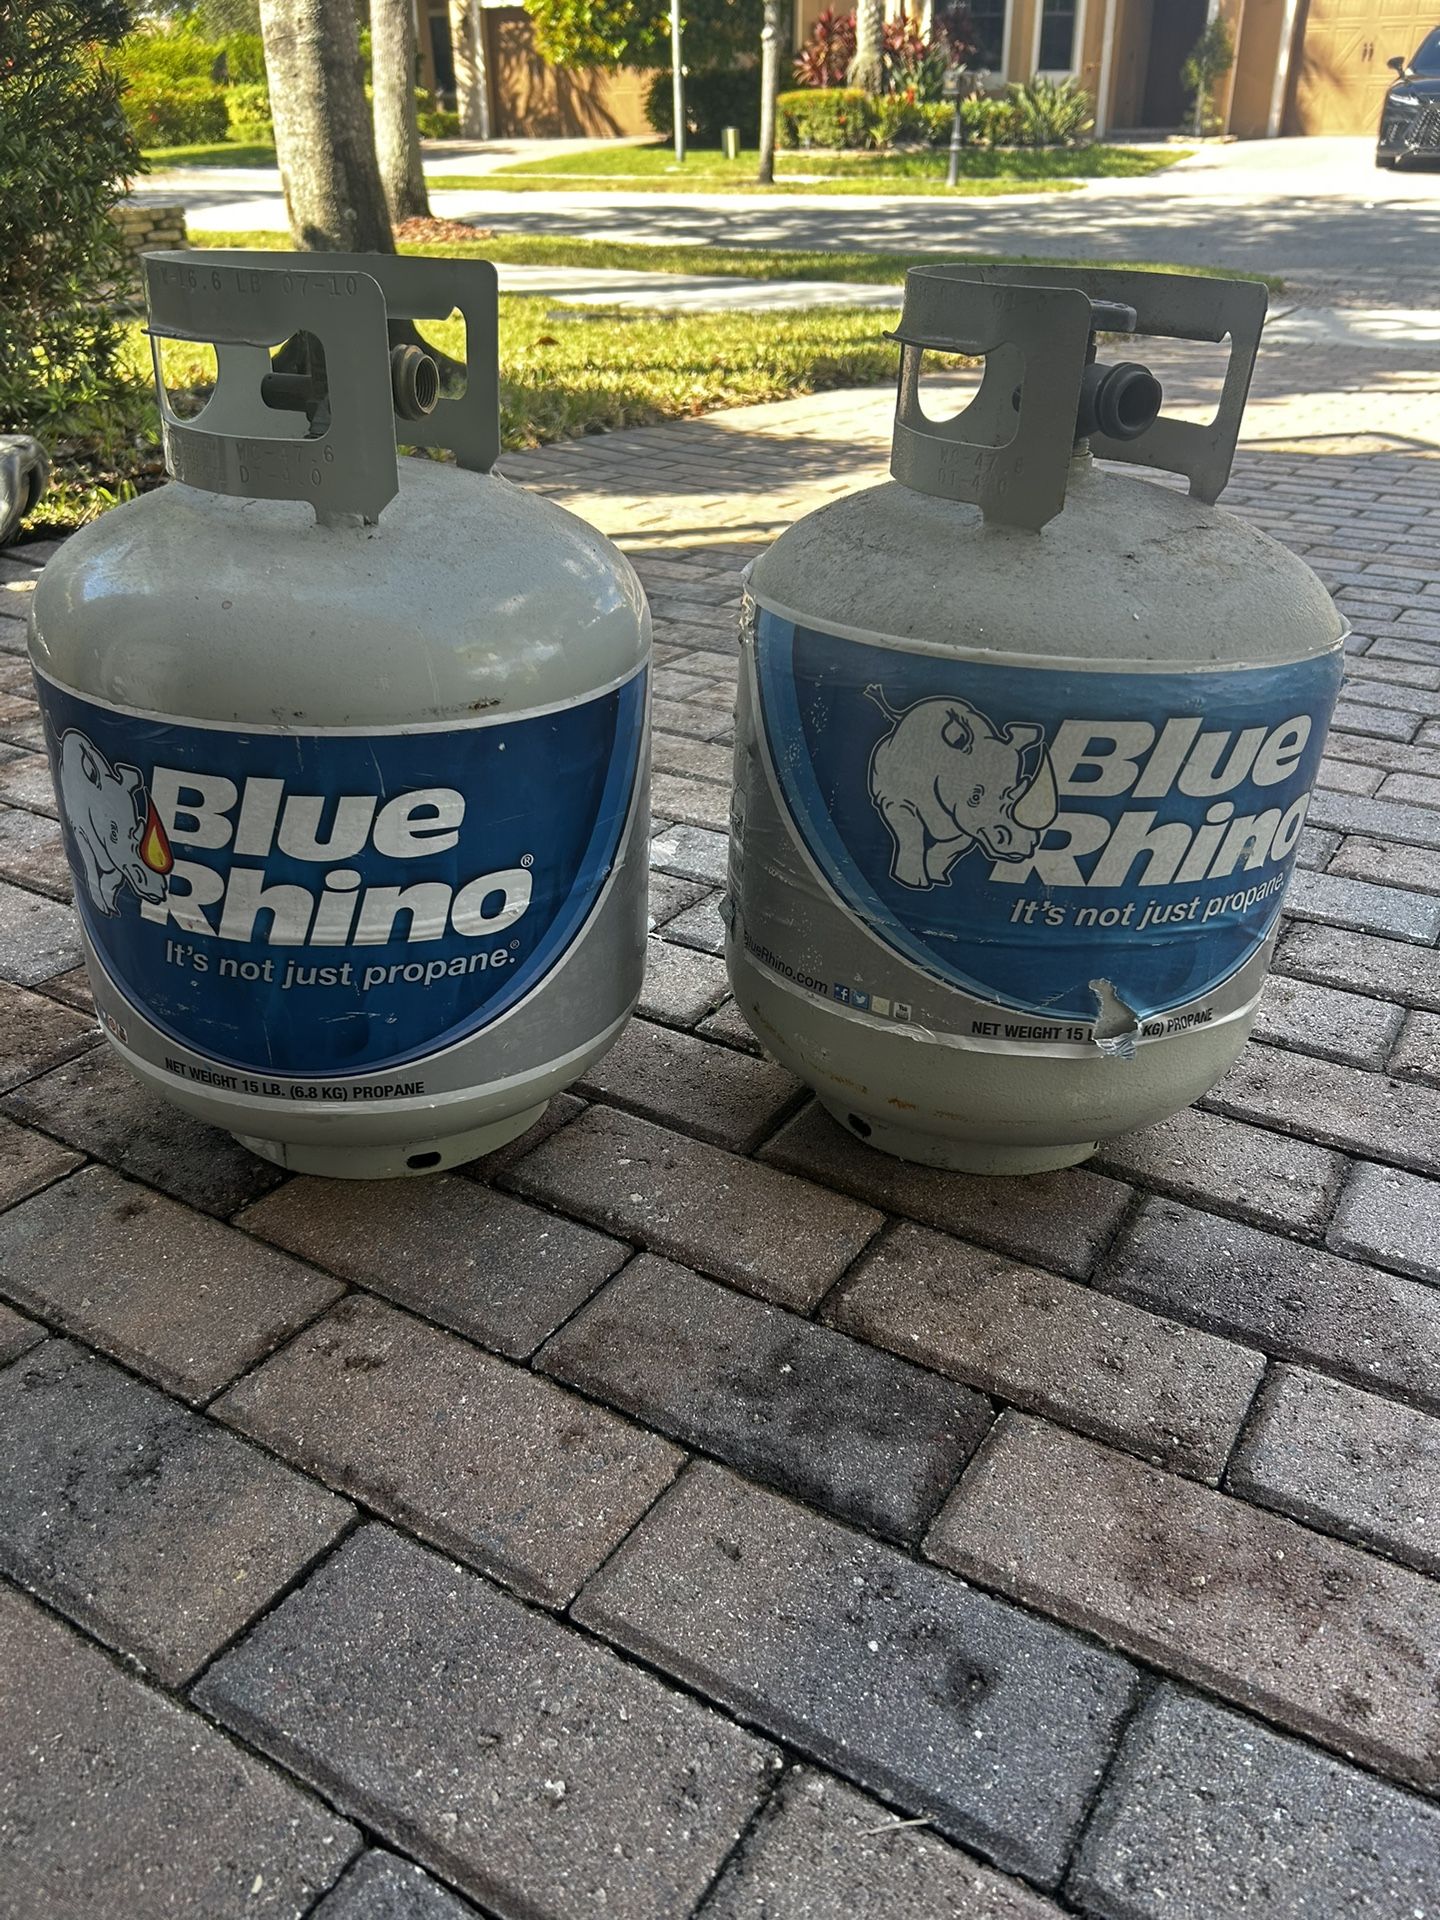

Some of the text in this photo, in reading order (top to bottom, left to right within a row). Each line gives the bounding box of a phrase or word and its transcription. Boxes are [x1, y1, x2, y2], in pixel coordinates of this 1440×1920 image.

[1050, 715, 1312, 798] Blue
[152, 766, 466, 862] Blue
[988, 792, 1312, 887] Rhino
[1010, 898, 1067, 927] It's
[1074, 904, 1136, 927] not
[1136, 896, 1201, 931] just
[165, 939, 209, 972] It's
[219, 959, 275, 982] not
[282, 960, 353, 989] just
[971, 1021, 1002, 1038] NET
[1004, 1024, 1063, 1041] WEIGHT
[1066, 1027, 1084, 1041] 15
[1166, 1008, 1214, 1034] PROPANE
[165, 1057, 425, 1102] NET WEIGHT 15 LB. (6.8 KG) PROPANE
